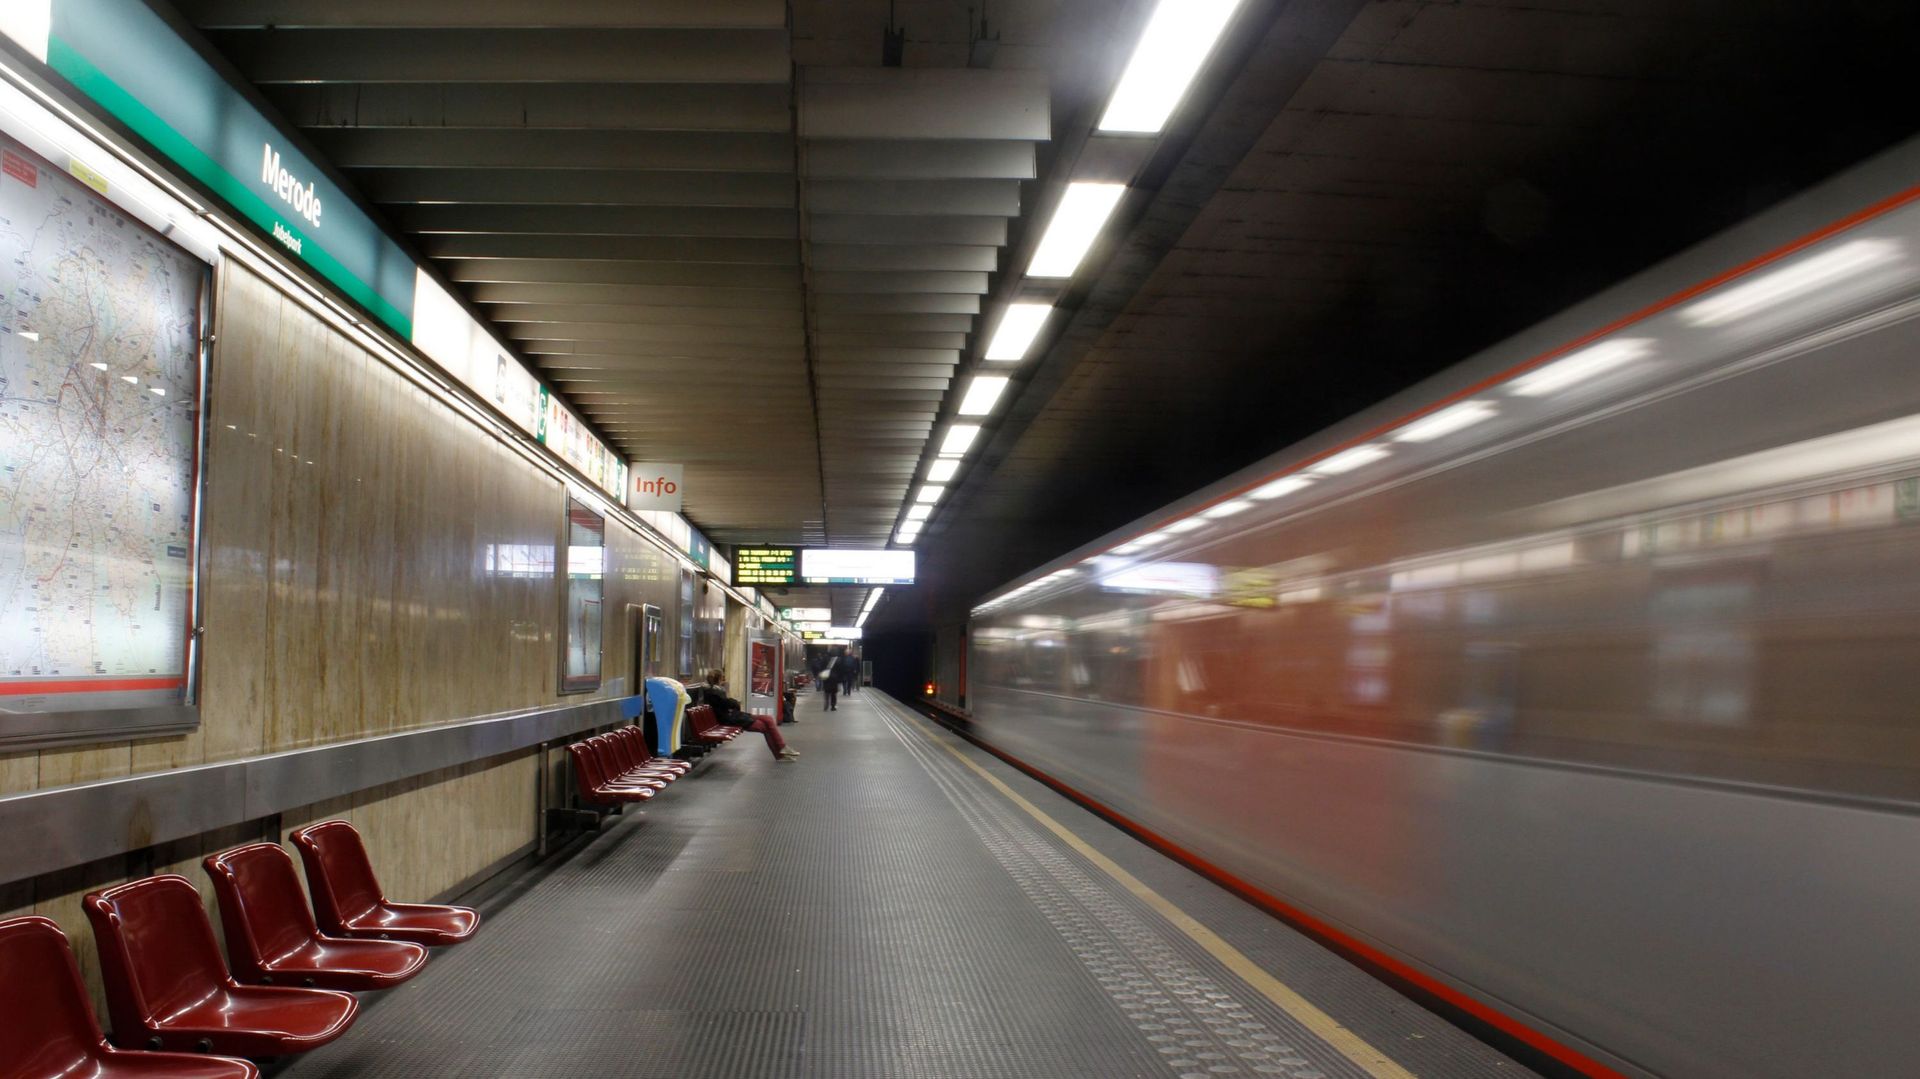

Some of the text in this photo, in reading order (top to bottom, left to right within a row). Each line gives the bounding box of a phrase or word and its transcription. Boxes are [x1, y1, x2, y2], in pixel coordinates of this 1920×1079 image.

[262, 143, 322, 228] Merode
[272, 221, 302, 255] Jubelpark
[636, 476, 677, 497] Info
